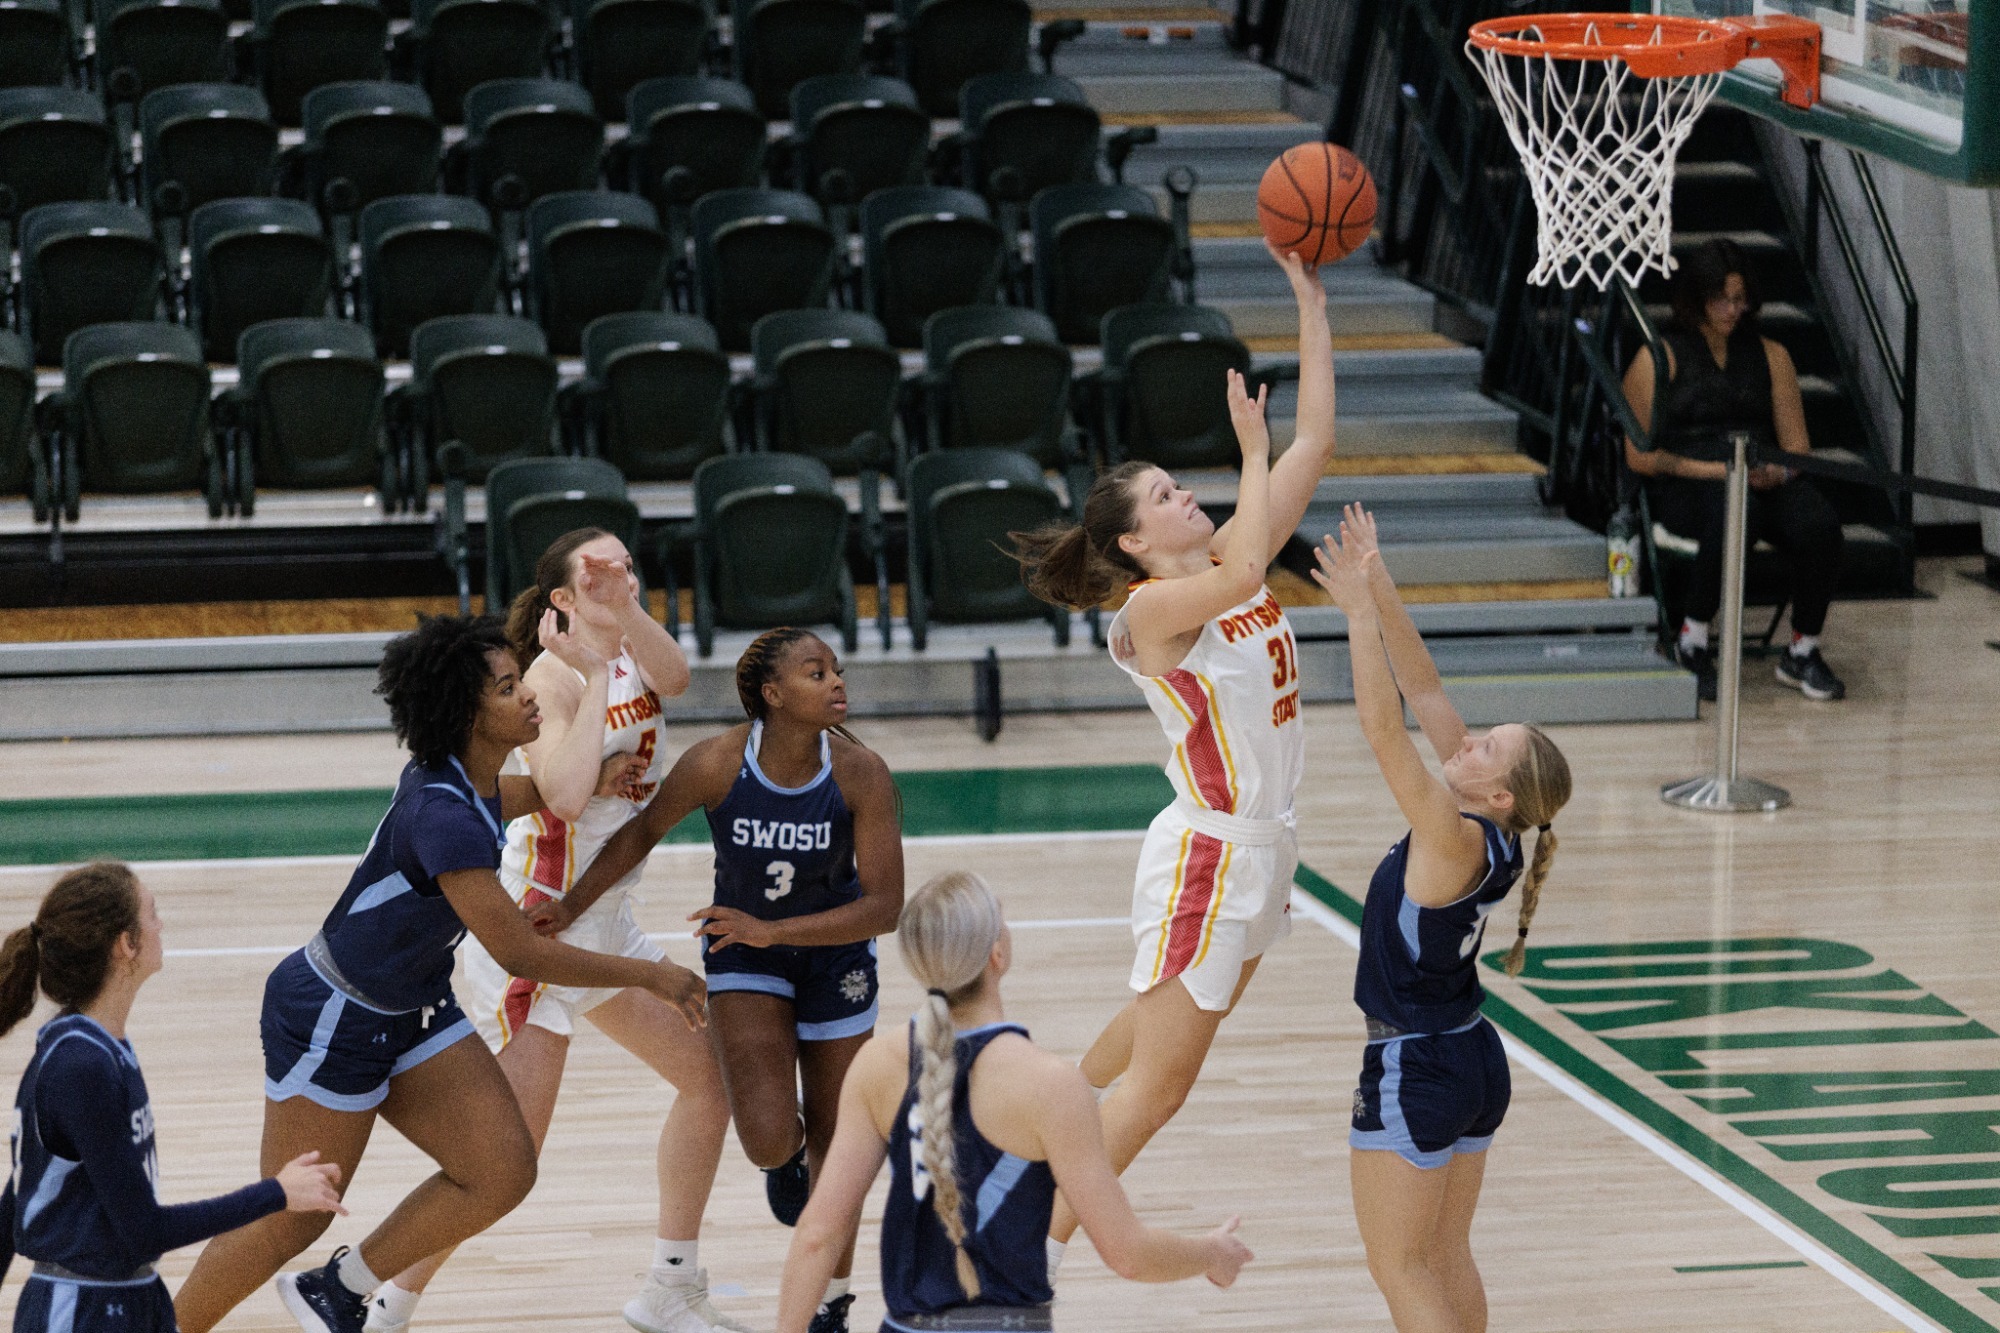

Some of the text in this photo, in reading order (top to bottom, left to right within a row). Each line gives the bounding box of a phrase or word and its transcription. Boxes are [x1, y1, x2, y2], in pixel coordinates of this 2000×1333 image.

[1267, 631, 1297, 690] 31
[732, 817, 831, 851] SWOSU
[764, 860, 795, 901] 3
